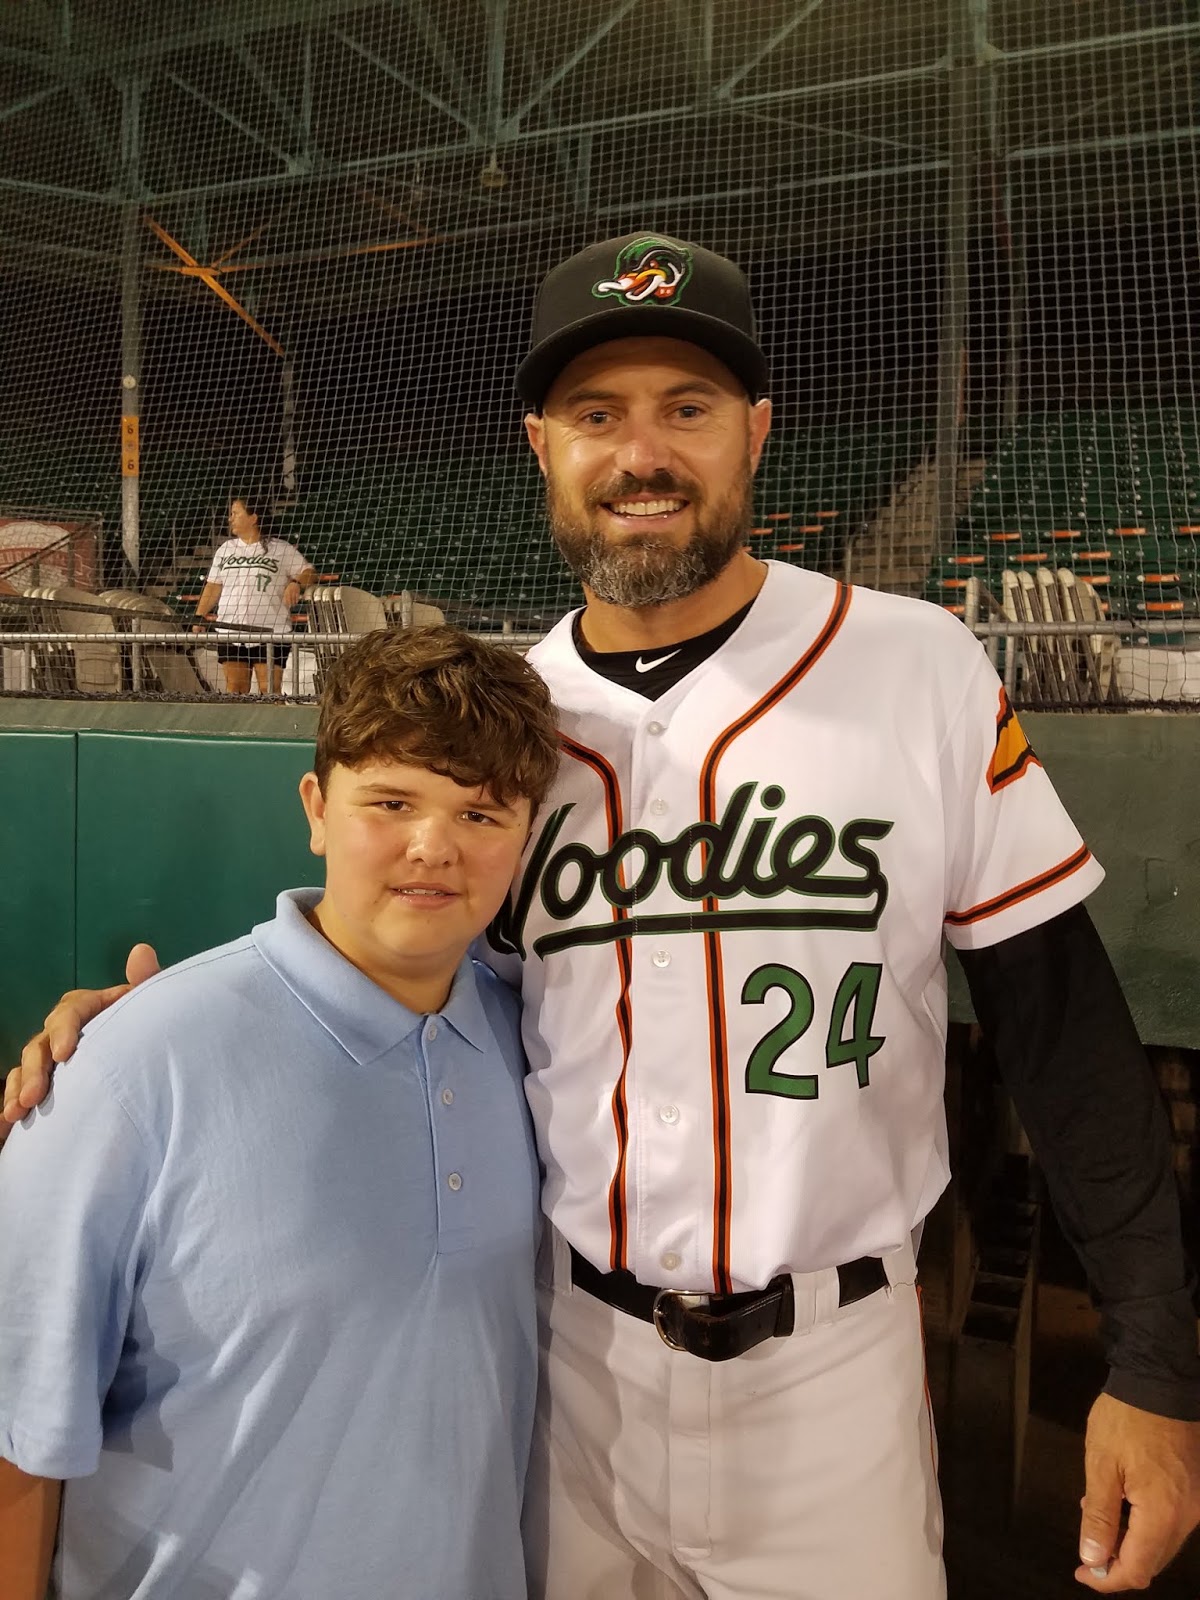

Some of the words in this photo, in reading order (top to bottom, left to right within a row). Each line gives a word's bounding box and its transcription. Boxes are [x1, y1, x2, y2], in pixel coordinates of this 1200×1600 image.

[218, 553, 279, 573] Woodies
[256, 573, 272, 592] 17
[740, 961, 886, 1100] 24
